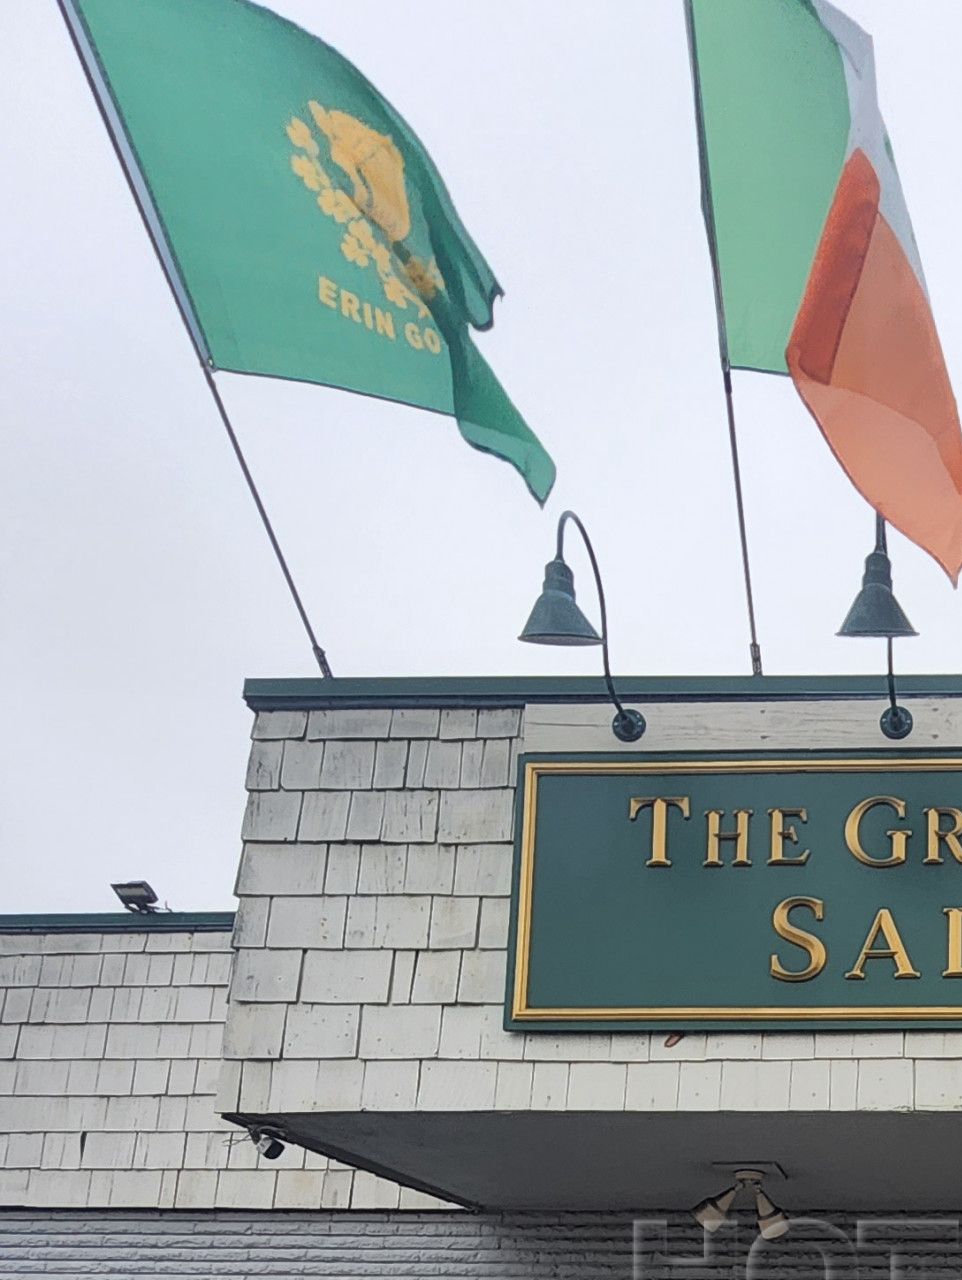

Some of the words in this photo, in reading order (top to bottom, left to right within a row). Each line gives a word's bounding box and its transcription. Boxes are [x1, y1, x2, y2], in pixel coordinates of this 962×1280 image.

[318, 275, 397, 341] ERIN
[404, 321, 442, 355] GO
[628, 795, 812, 868] THE
